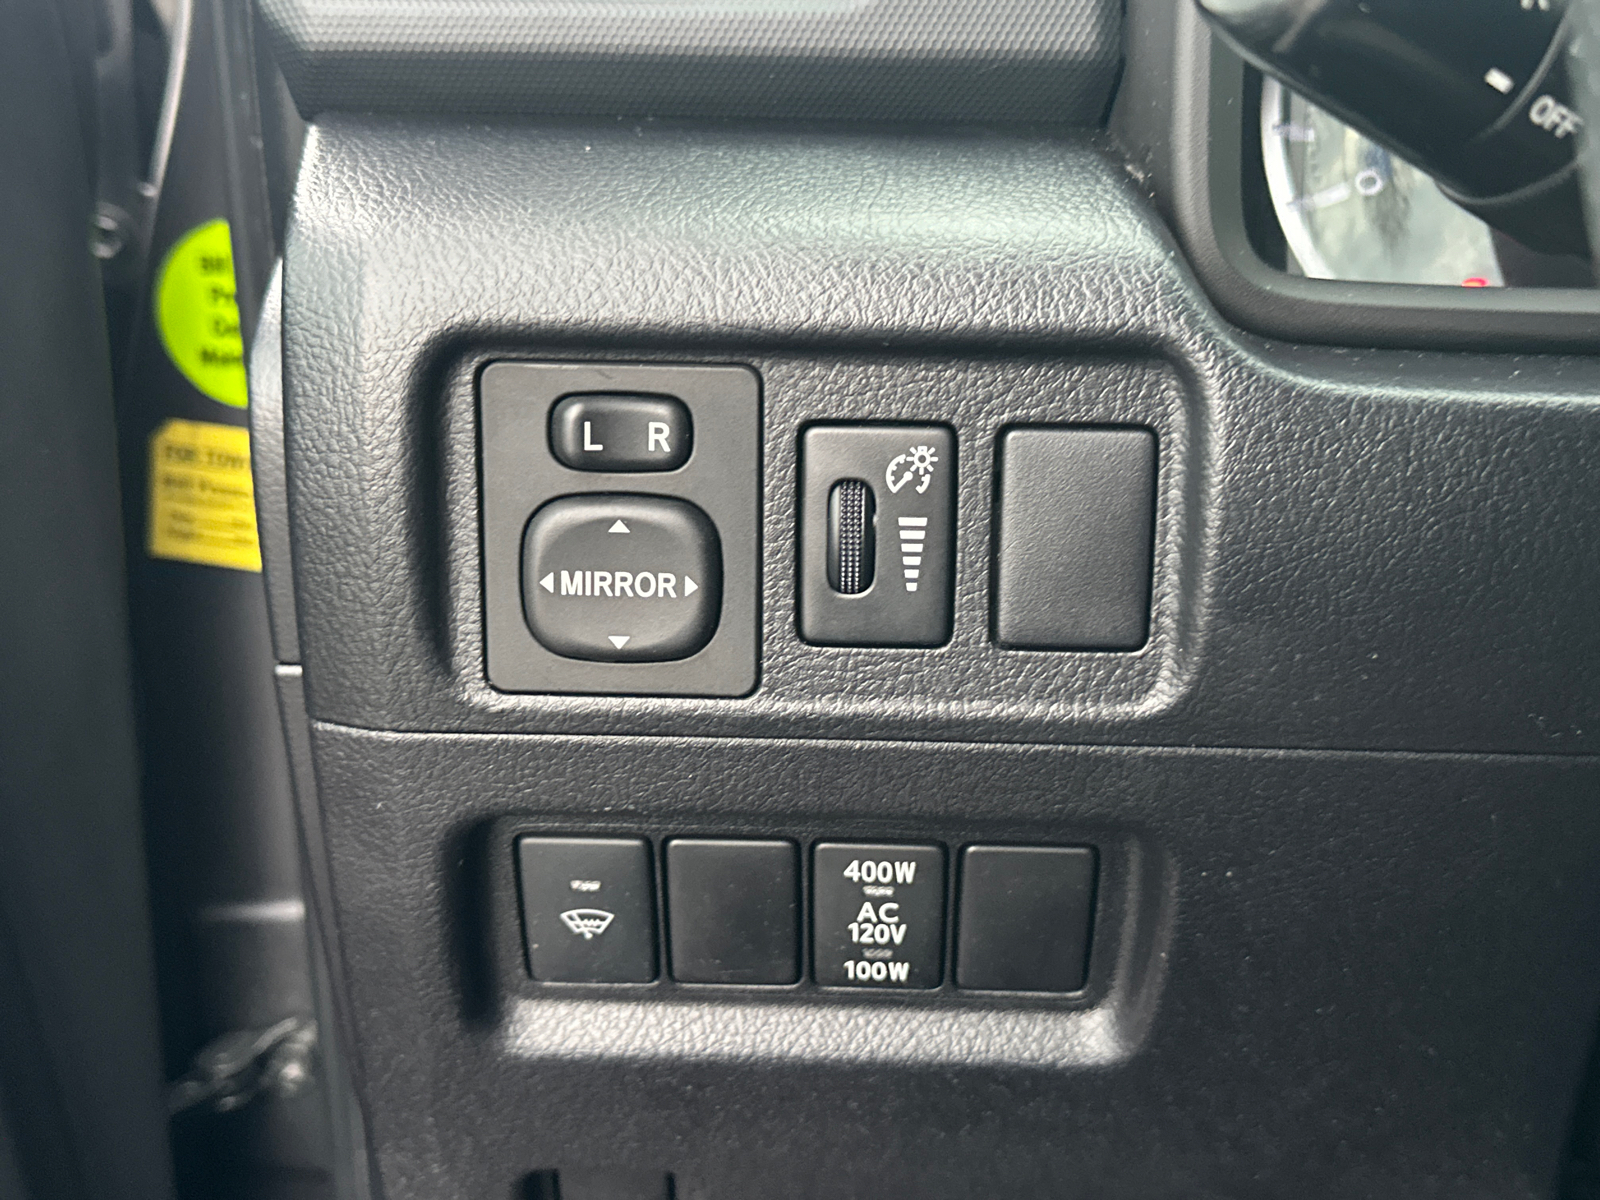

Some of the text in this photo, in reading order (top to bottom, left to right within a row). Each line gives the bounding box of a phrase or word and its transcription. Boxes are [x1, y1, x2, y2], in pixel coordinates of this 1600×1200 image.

[1528, 94, 1584, 139] OFF
[583, 421, 671, 452] L R
[560, 570, 677, 598] MIRROR
[843, 859, 916, 884] 400W
[856, 901, 900, 923] AC
[847, 922, 907, 945] 120V
[843, 960, 910, 982] 100W
